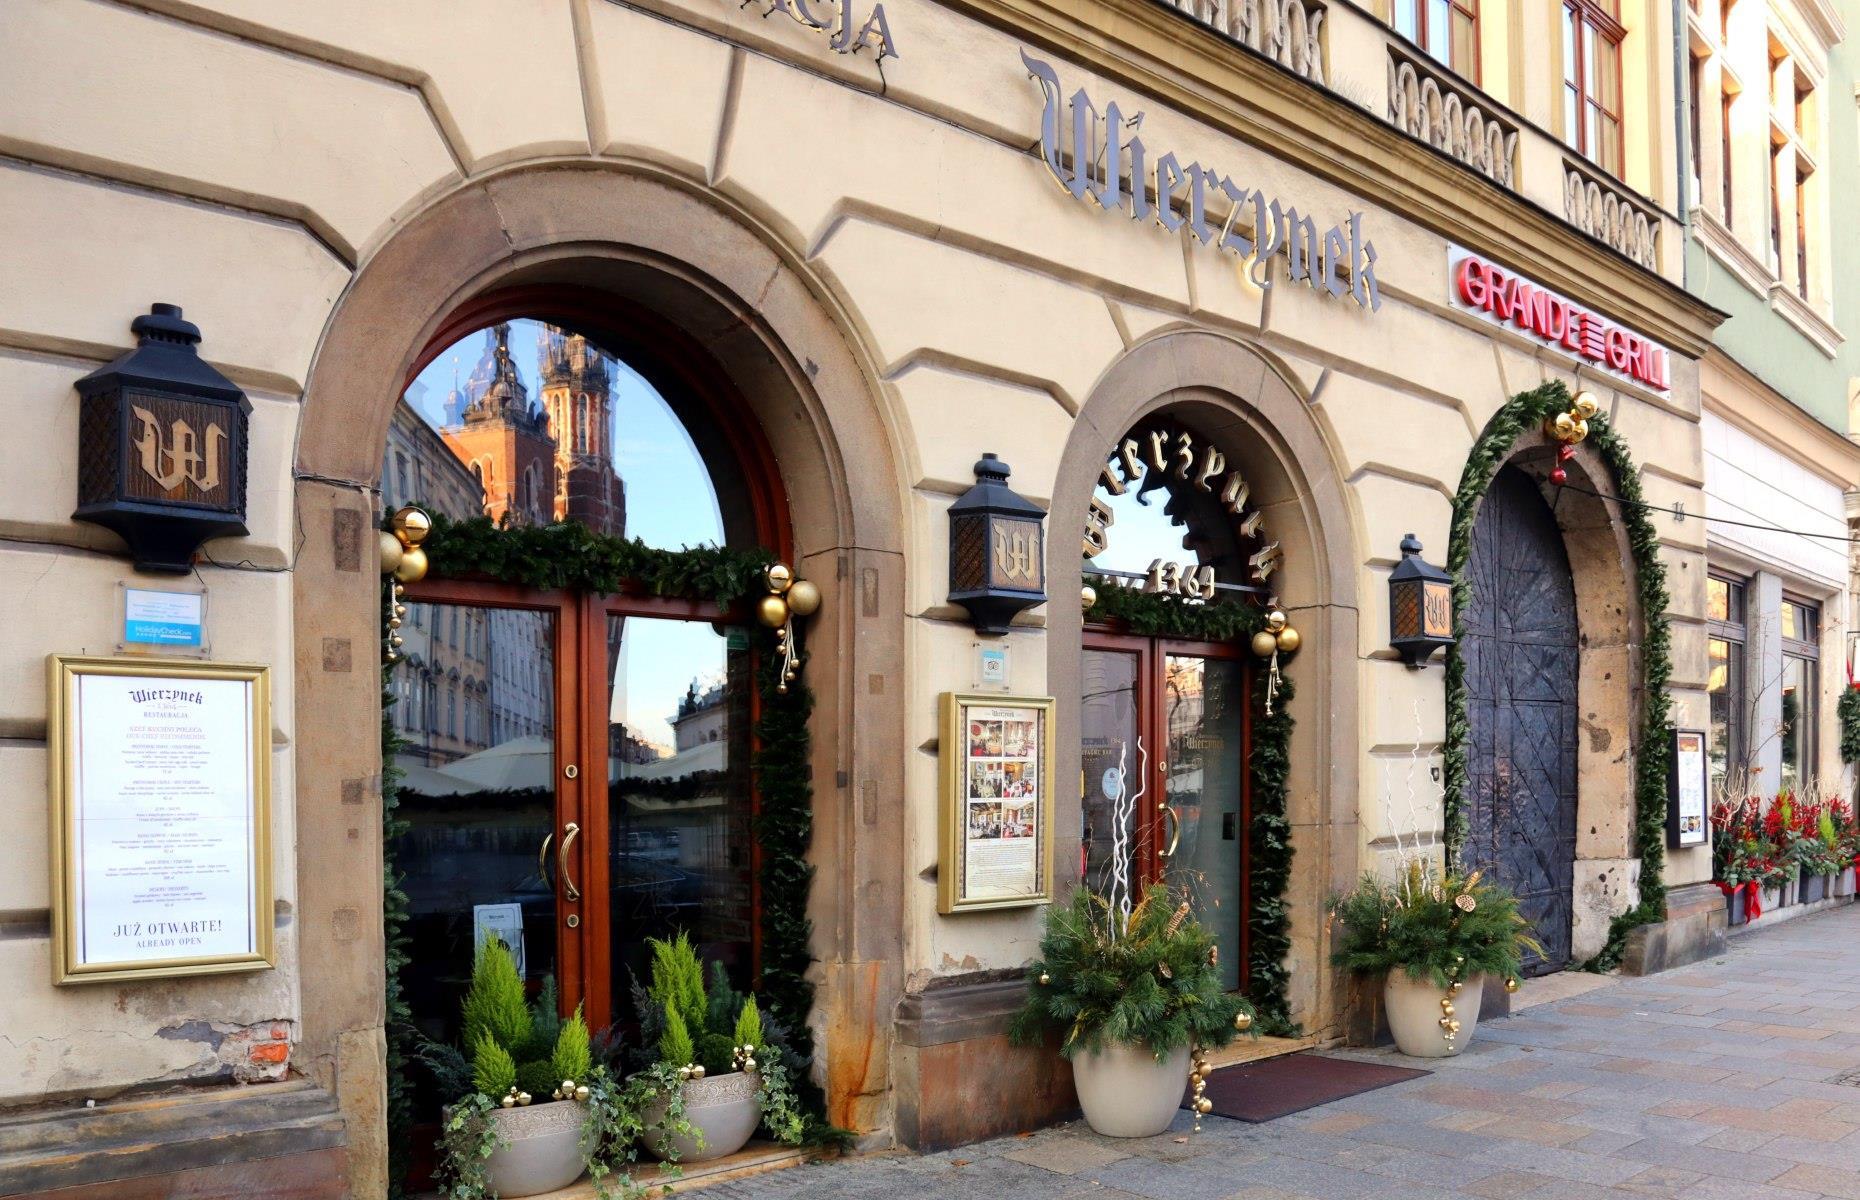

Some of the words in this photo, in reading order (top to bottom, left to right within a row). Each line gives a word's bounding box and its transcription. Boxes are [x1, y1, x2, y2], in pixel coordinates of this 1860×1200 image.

[1019, 46, 1382, 313] Wierzynek
[1457, 256, 1583, 352] GRANDE
[1605, 327, 1671, 391] GRILL
[128, 689, 203, 704] Wierzynek
[113, 922, 142, 937] JUŻ
[148, 919, 222, 935] OTWARTE!
[136, 938, 175, 948] ALREADY
[179, 936, 202, 945] OPEN
